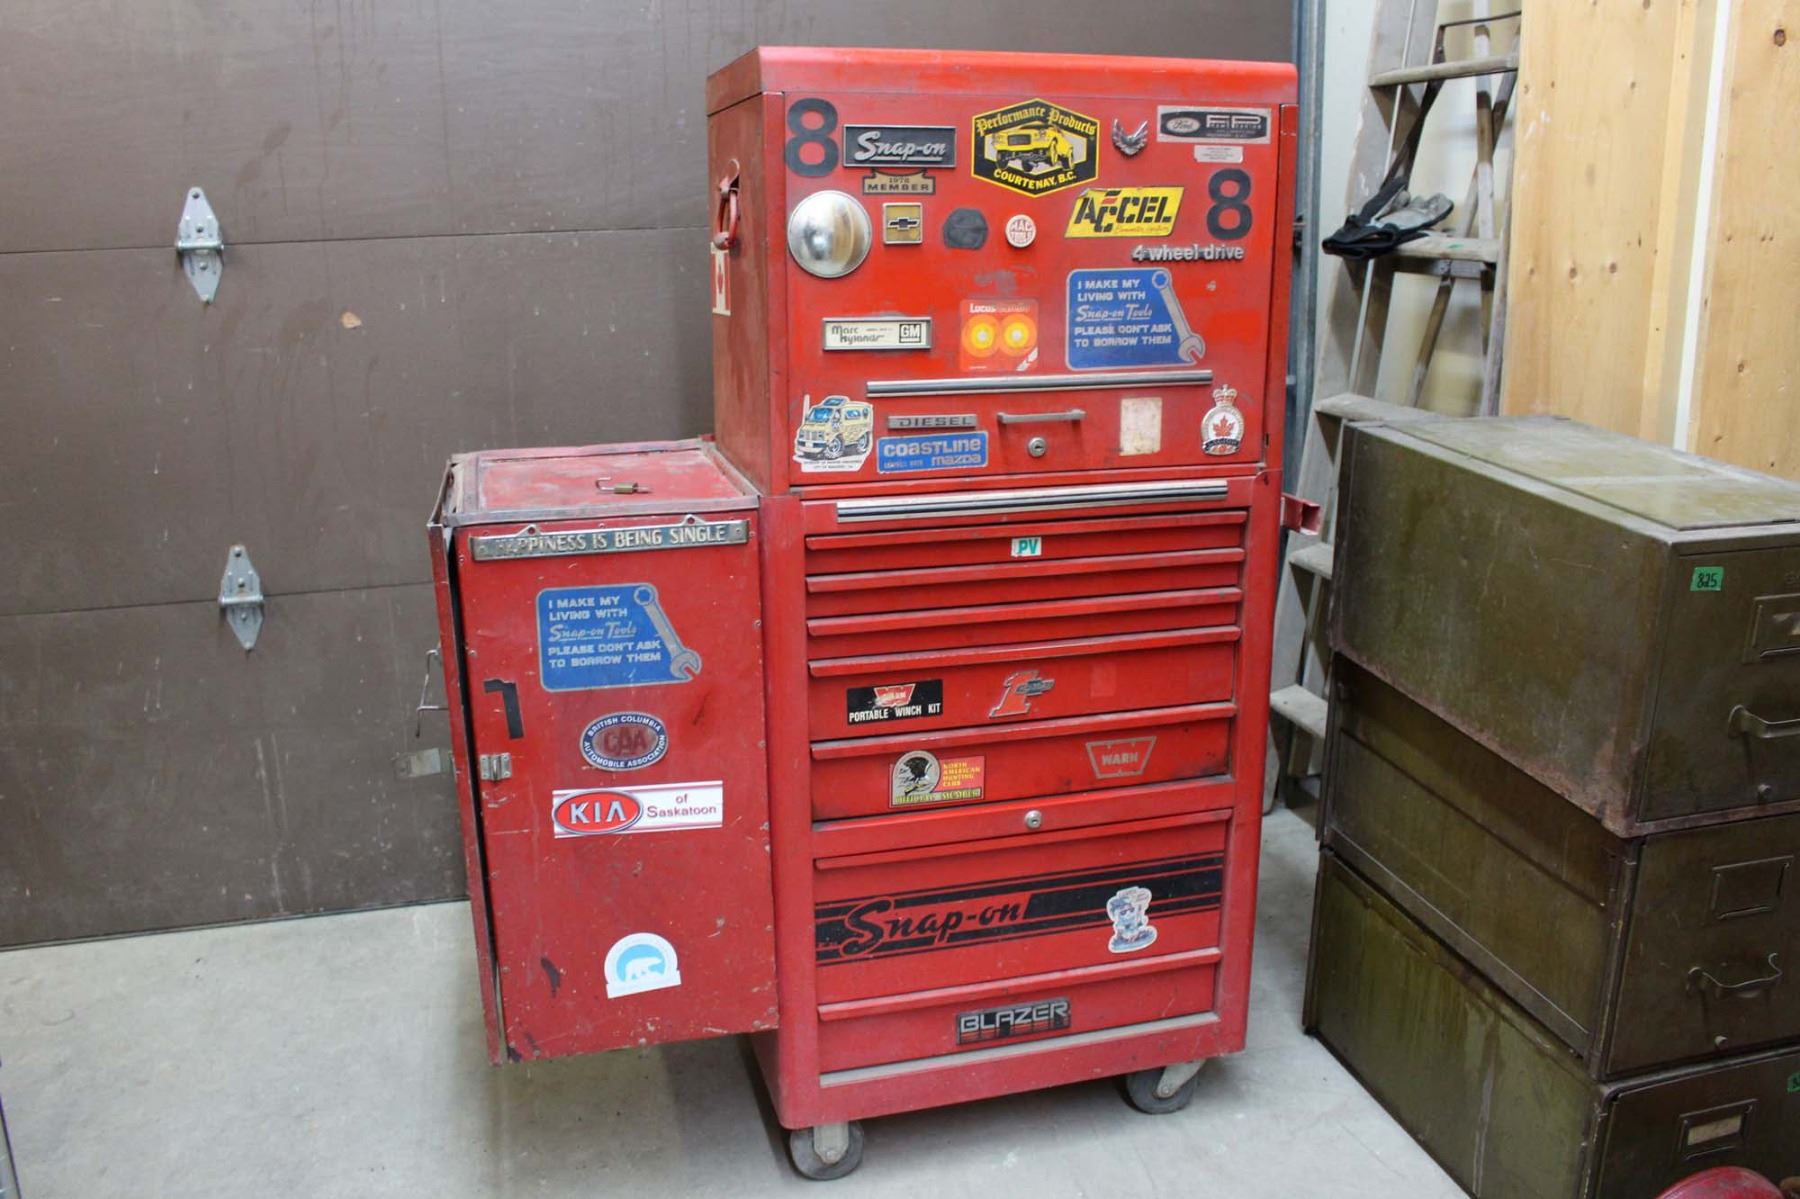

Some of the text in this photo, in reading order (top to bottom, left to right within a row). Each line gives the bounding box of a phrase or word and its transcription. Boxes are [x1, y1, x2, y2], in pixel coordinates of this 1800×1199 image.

[976, 107, 1096, 136] Performance Products
[786, 98, 838, 177] 8
[854, 131, 946, 161] Snap-on
[1058, 171, 1076, 184] B.C.
[867, 183, 929, 191] MEMBER
[1074, 190, 1172, 232] ACCEL
[1206, 168, 1252, 240] 8
[1132, 244, 1244, 260] 4 wheel drive
[1085, 280, 1118, 289] MAKE
[1122, 279, 1141, 288] MY
[1078, 291, 1146, 302] LIVING WITH
[1075, 304, 1152, 321] Snap-on Tools
[901, 325, 920, 337] GM
[1075, 323, 1172, 335] PLEASE DON'T ASK
[1075, 335, 1171, 347] TO BORROW THEM
[899, 416, 972, 428] DIESEL
[592, 532, 607, 549] IS
[614, 528, 662, 547] BEING
[670, 525, 726, 544] SINGLE
[1017, 538, 1039, 555] PV
[548, 595, 620, 609] I MAKE MY
[549, 607, 628, 621] LIVING WITH
[548, 621, 638, 642] Snap-on Tools
[548, 639, 661, 656] PLEASE DON'T ASK
[549, 652, 662, 668] TO BORROW THEM
[849, 702, 941, 723] PORTABLE WINCH KIT
[587, 715, 662, 737] BRITISH COLUMBIA
[584, 735, 665, 768] AUTOMOBILE ASSOCIATION
[1102, 752, 1138, 766] WARN
[675, 793, 688, 804] of
[570, 801, 627, 825] KIA
[647, 804, 717, 819] Saskatoon
[842, 898, 1019, 955] Snap-on
[961, 1001, 1068, 1033] BLAZER
